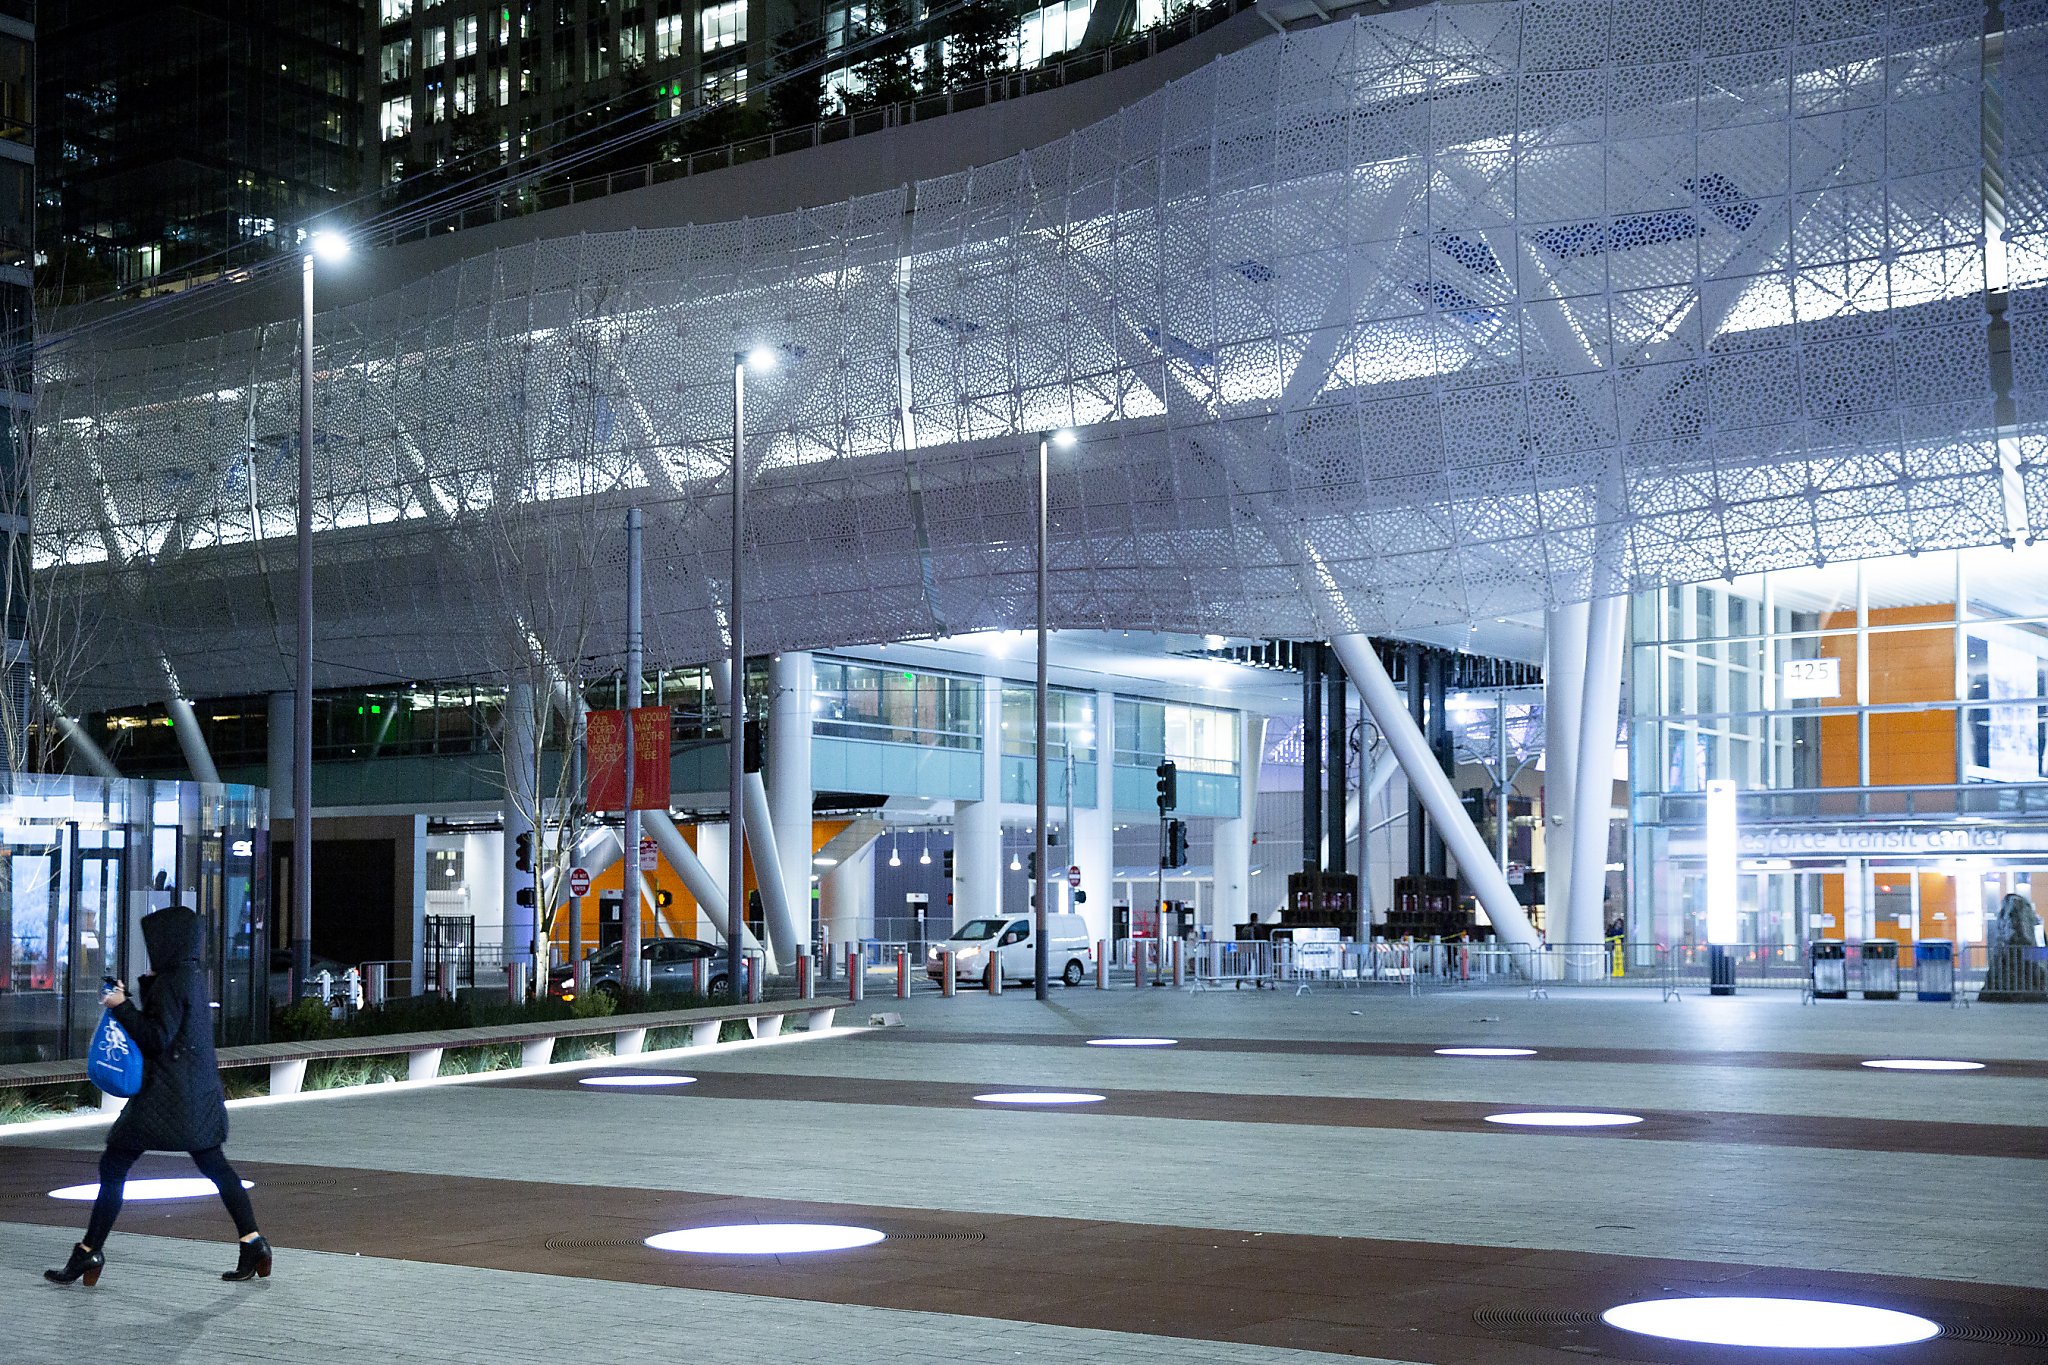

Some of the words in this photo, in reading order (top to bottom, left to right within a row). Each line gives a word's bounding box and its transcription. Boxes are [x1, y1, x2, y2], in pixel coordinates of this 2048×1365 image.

[1791, 662, 1829, 680] 425
[594, 715, 608, 725] OUR
[640, 712, 668, 722] WOOLLY
[1737, 828, 1826, 856] lesforce
[1838, 826, 1917, 848] transit
[1927, 827, 2008, 848] center
